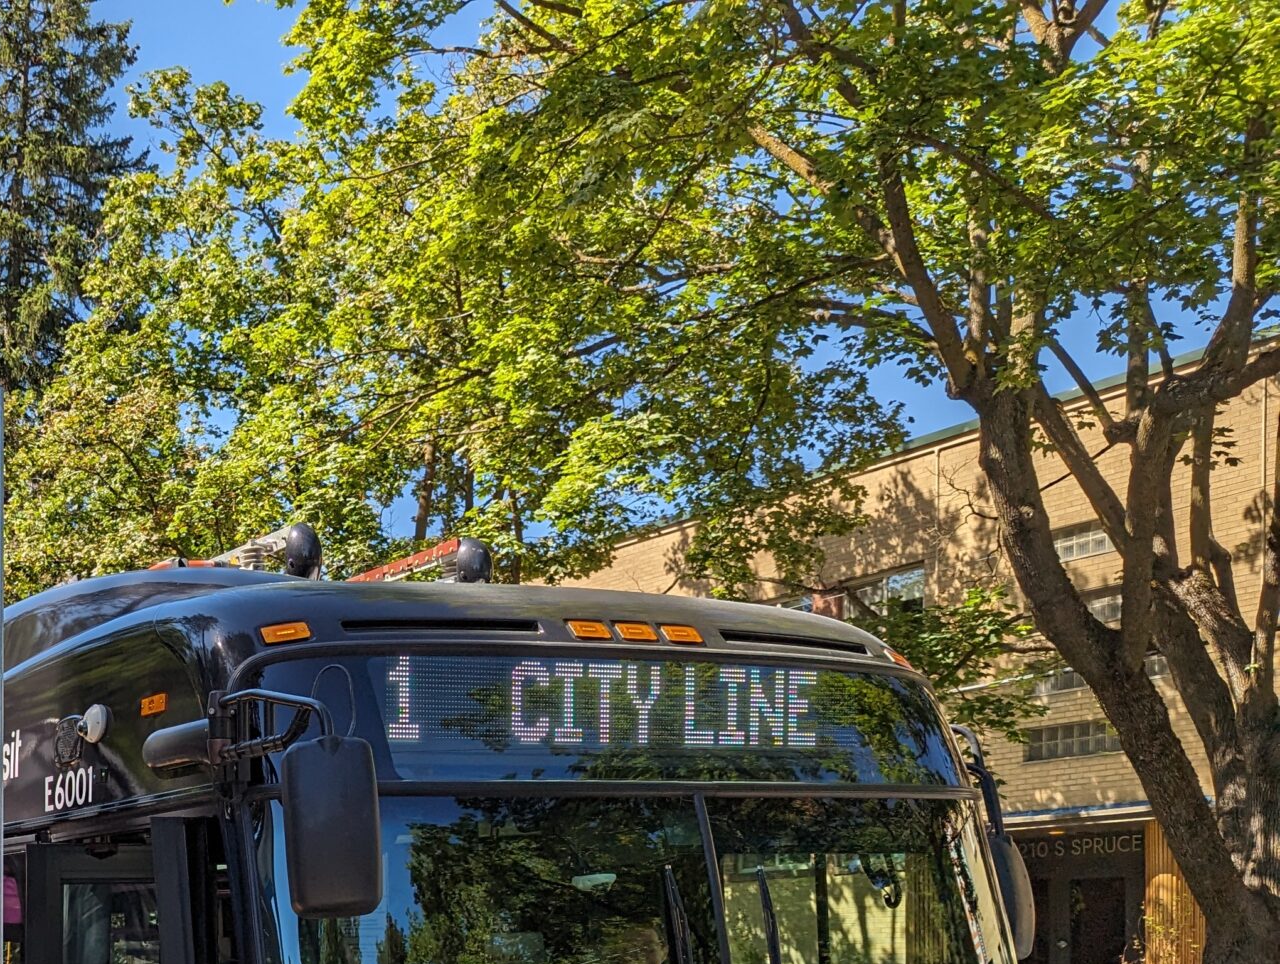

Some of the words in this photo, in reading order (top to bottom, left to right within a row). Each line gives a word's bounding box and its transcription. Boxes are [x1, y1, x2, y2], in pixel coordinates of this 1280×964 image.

[388, 655, 421, 741] 1
[511, 660, 661, 745] CITY
[683, 666, 818, 746] LINE
[44, 766, 93, 812] E6001
[1054, 841, 1065, 856] S
[1071, 835, 1142, 855] SPRUCE
